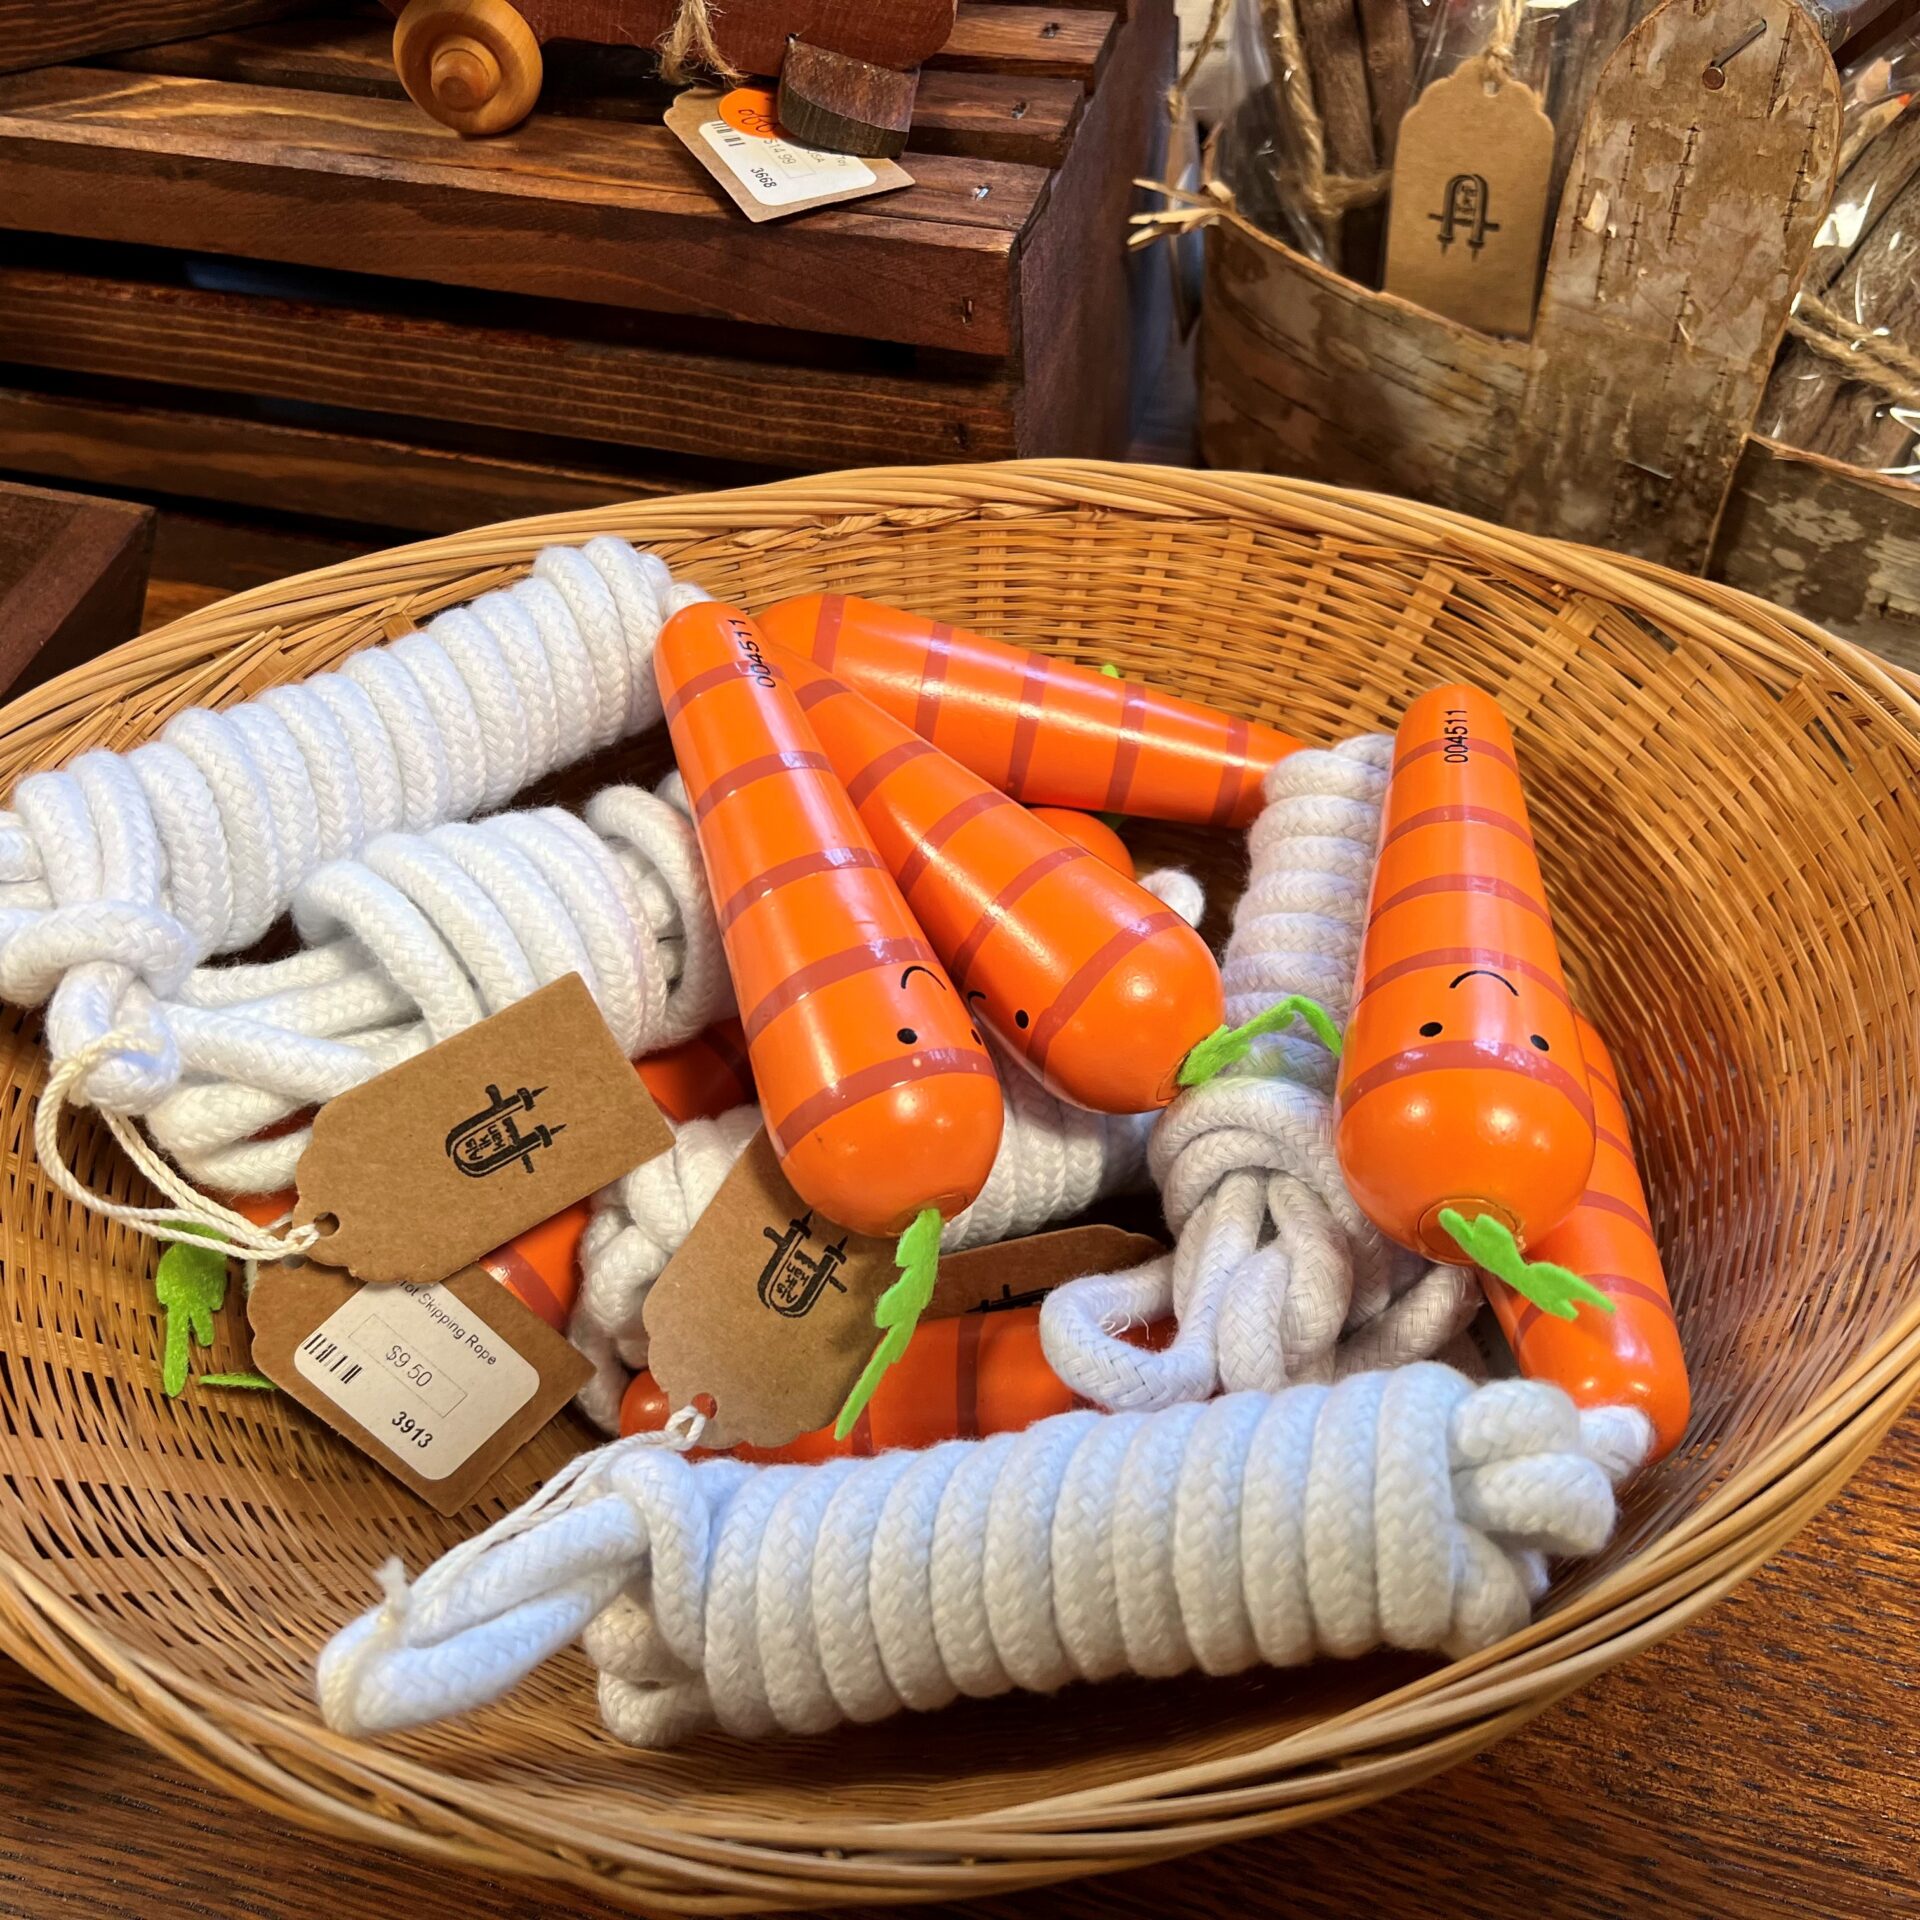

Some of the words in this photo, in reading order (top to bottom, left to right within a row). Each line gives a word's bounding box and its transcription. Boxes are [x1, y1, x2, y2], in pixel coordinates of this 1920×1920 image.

[750, 167, 777, 188] 3668
[727, 619, 776, 688] 004511
[1444, 710, 1469, 763] 004511
[465, 1138, 483, 1161] Als
[418, 1292, 466, 1339] Skipping
[465, 1334, 497, 1365] Rope
[391, 1411, 434, 1449] 3913
